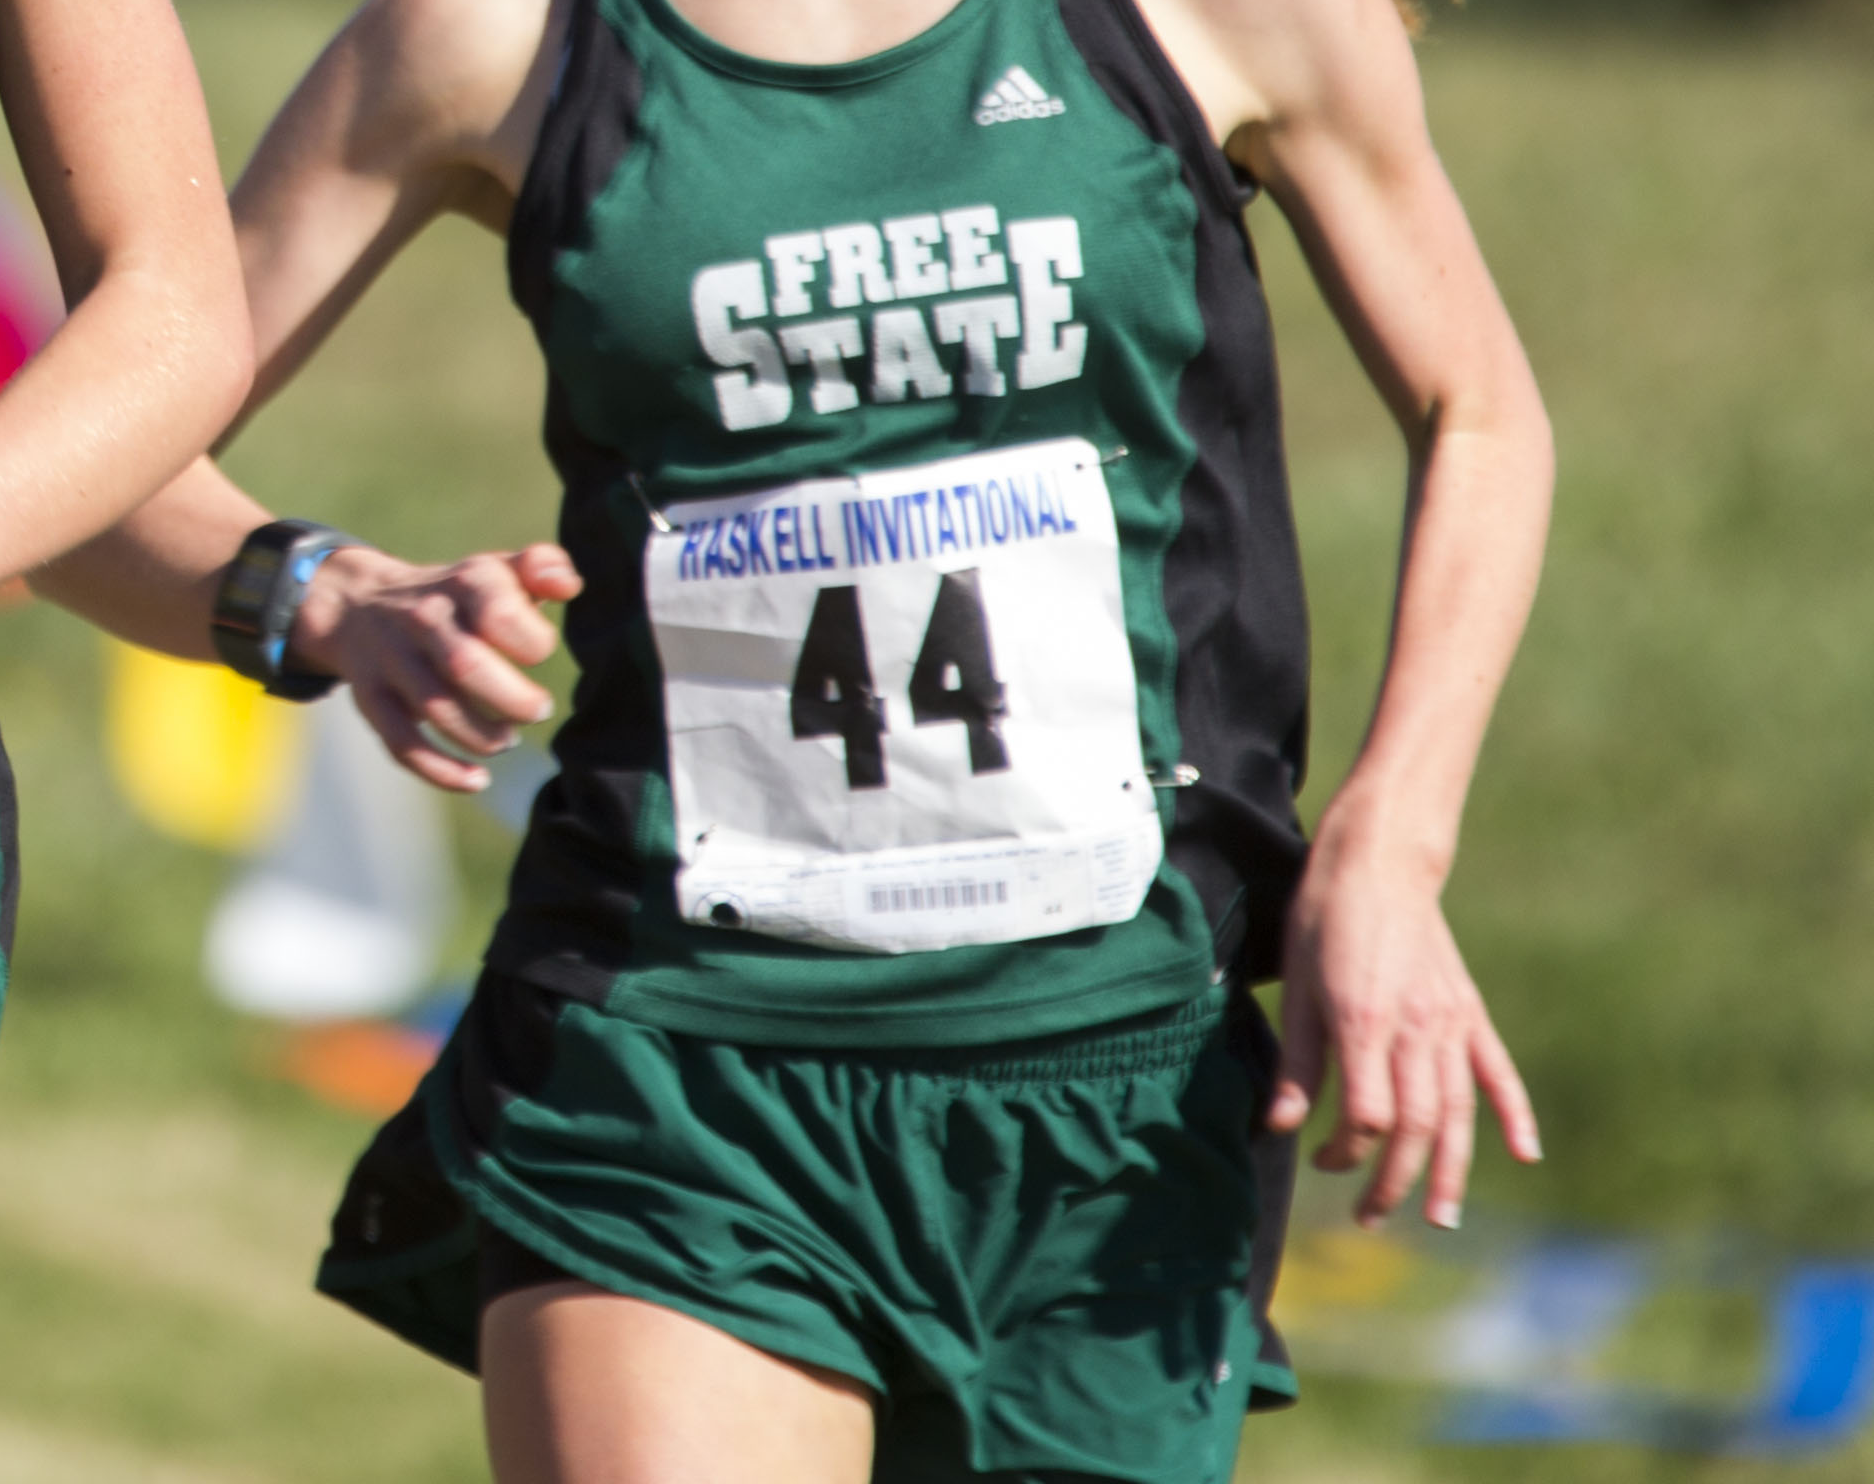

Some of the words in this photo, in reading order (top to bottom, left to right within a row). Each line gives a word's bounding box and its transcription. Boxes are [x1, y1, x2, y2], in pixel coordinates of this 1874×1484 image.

[974, 97, 1066, 126] adidas
[765, 204, 1008, 317] FREE
[692, 216, 1088, 432] STATE
[678, 503, 835, 581] HASKELL
[840, 471, 1077, 569] INVITATIONAL
[790, 566, 1011, 791] 44
